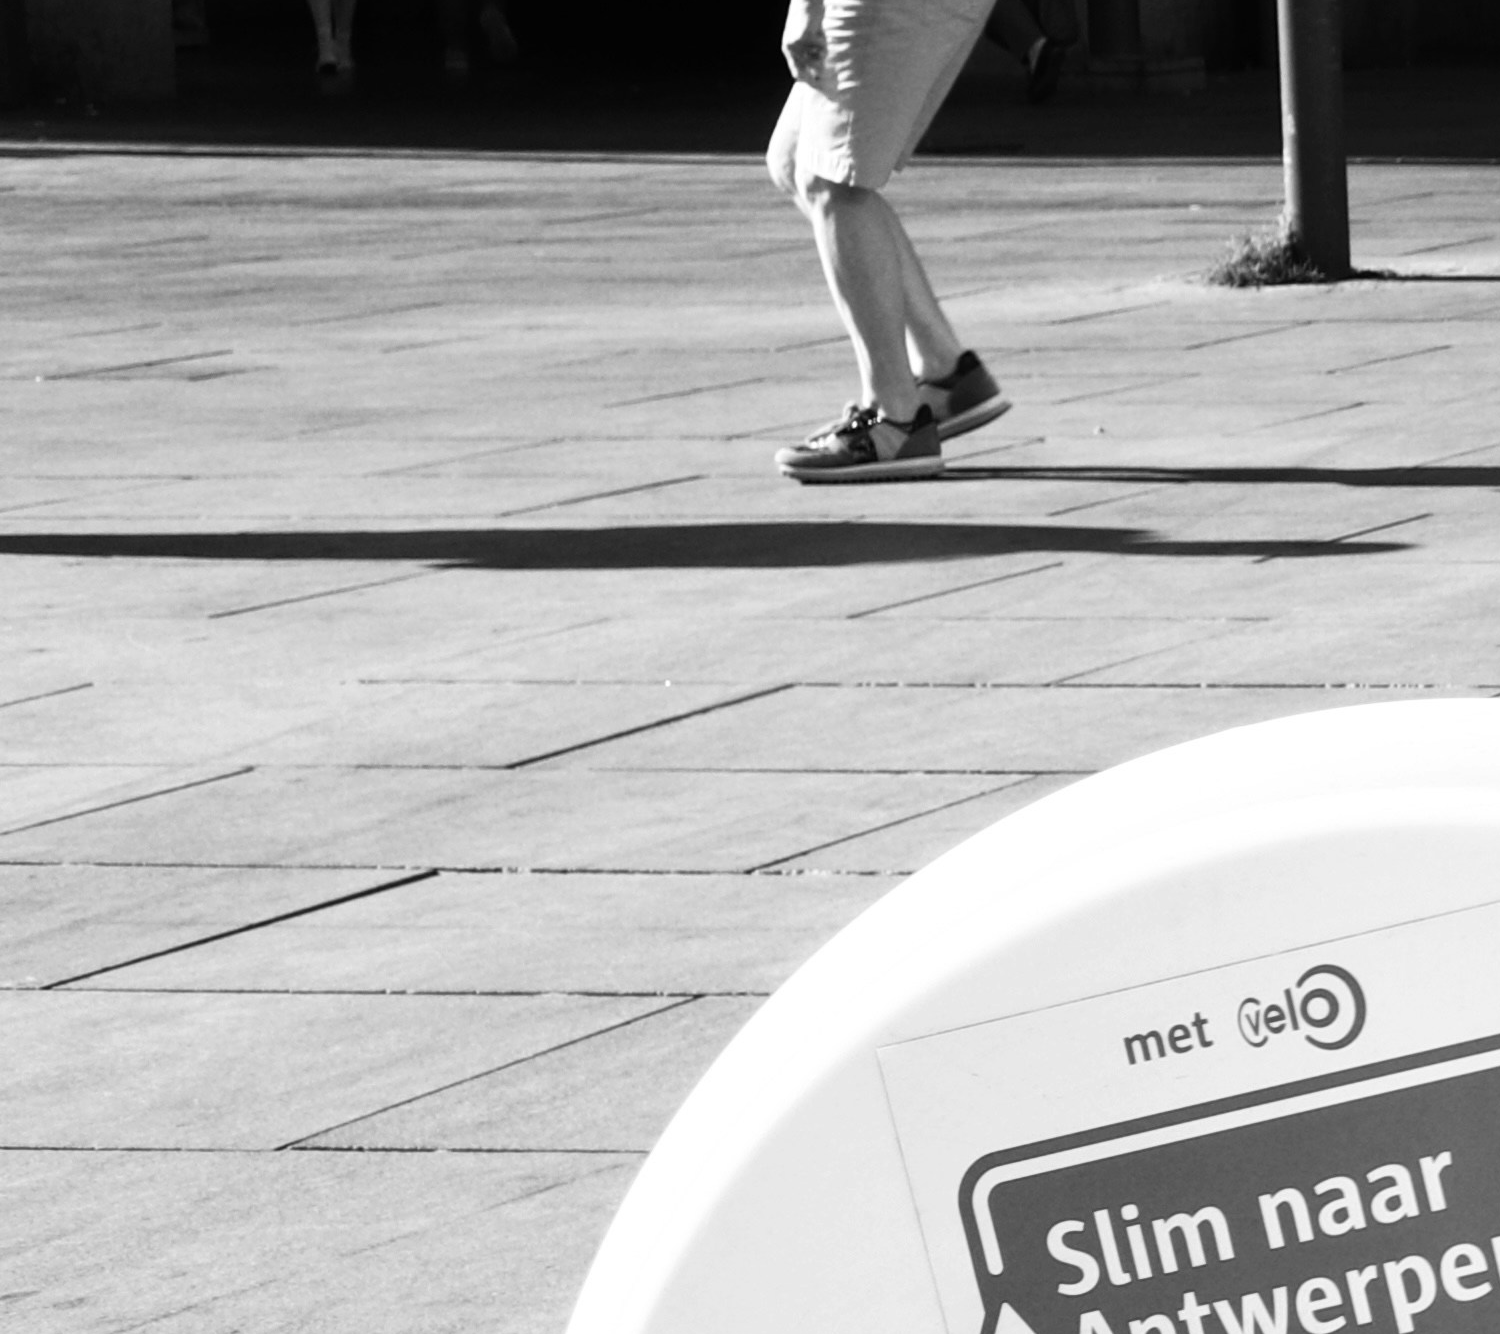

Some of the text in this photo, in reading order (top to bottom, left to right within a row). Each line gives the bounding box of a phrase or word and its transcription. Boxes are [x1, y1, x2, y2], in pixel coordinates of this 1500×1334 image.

[1123, 1010, 1213, 1064] met
[1045, 1150, 1452, 1298] Slim naar
